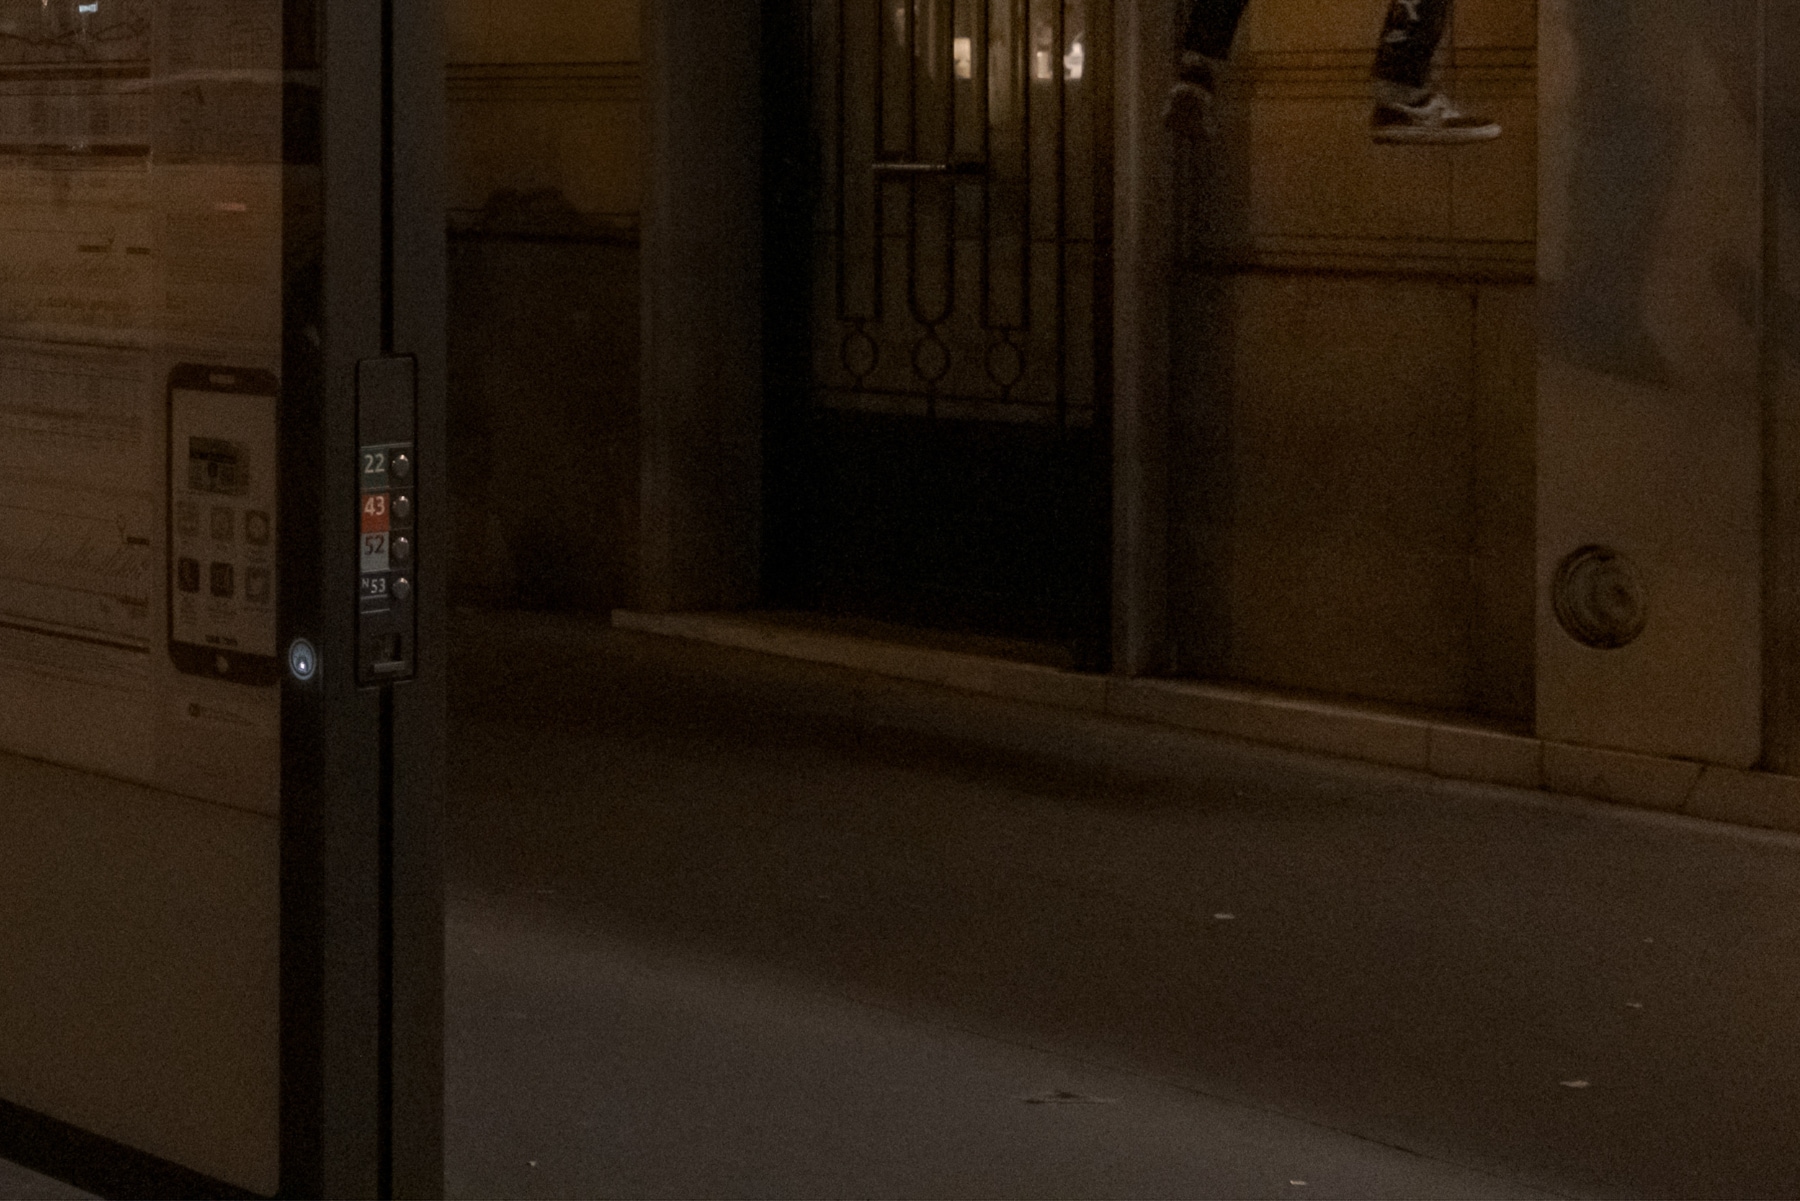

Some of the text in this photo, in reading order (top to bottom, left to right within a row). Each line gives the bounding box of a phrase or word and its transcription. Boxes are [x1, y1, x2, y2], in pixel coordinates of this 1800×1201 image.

[363, 452, 386, 474] 22
[363, 495, 386, 517] 43
[364, 534, 385, 556] 52
[361, 577, 387, 594] N53
